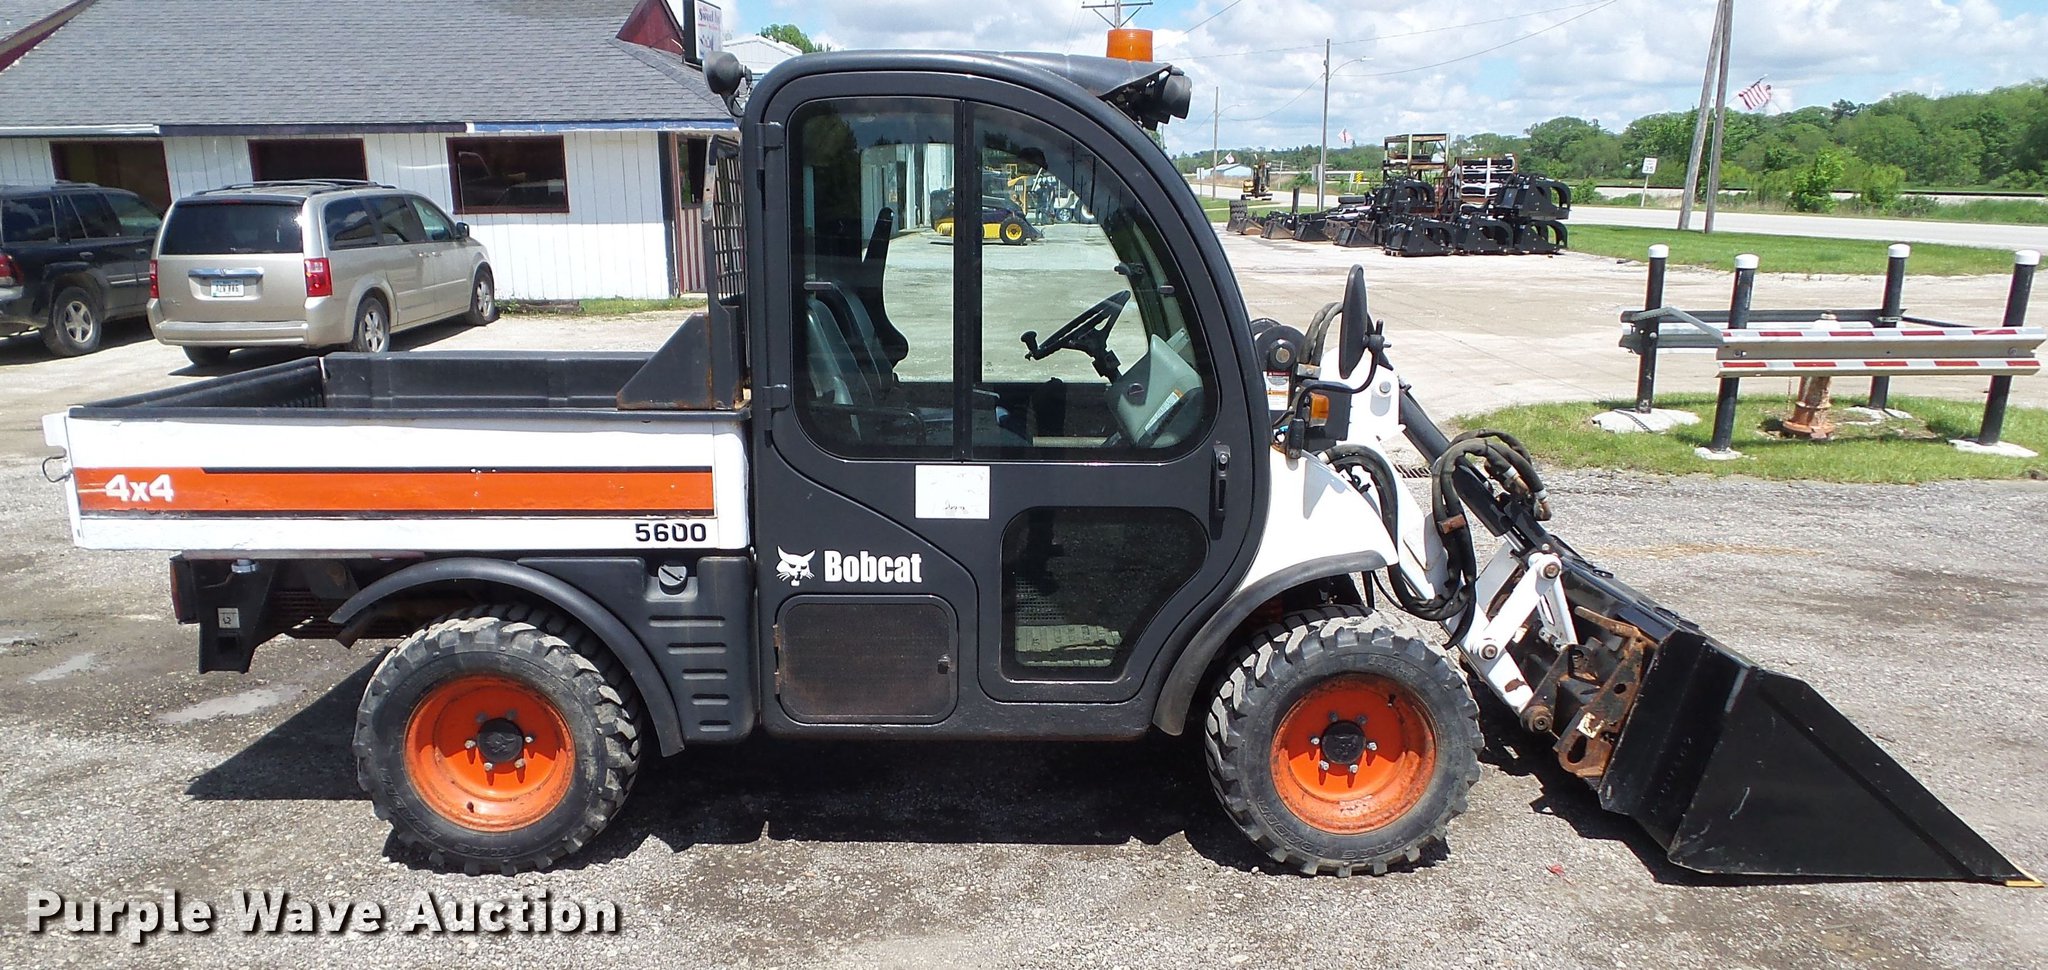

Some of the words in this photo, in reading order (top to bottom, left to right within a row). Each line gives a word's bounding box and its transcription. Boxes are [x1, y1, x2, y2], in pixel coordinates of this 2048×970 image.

[104, 473, 175, 502] 4x4
[635, 523, 707, 542] 5600
[824, 550, 923, 583] Bobcat
